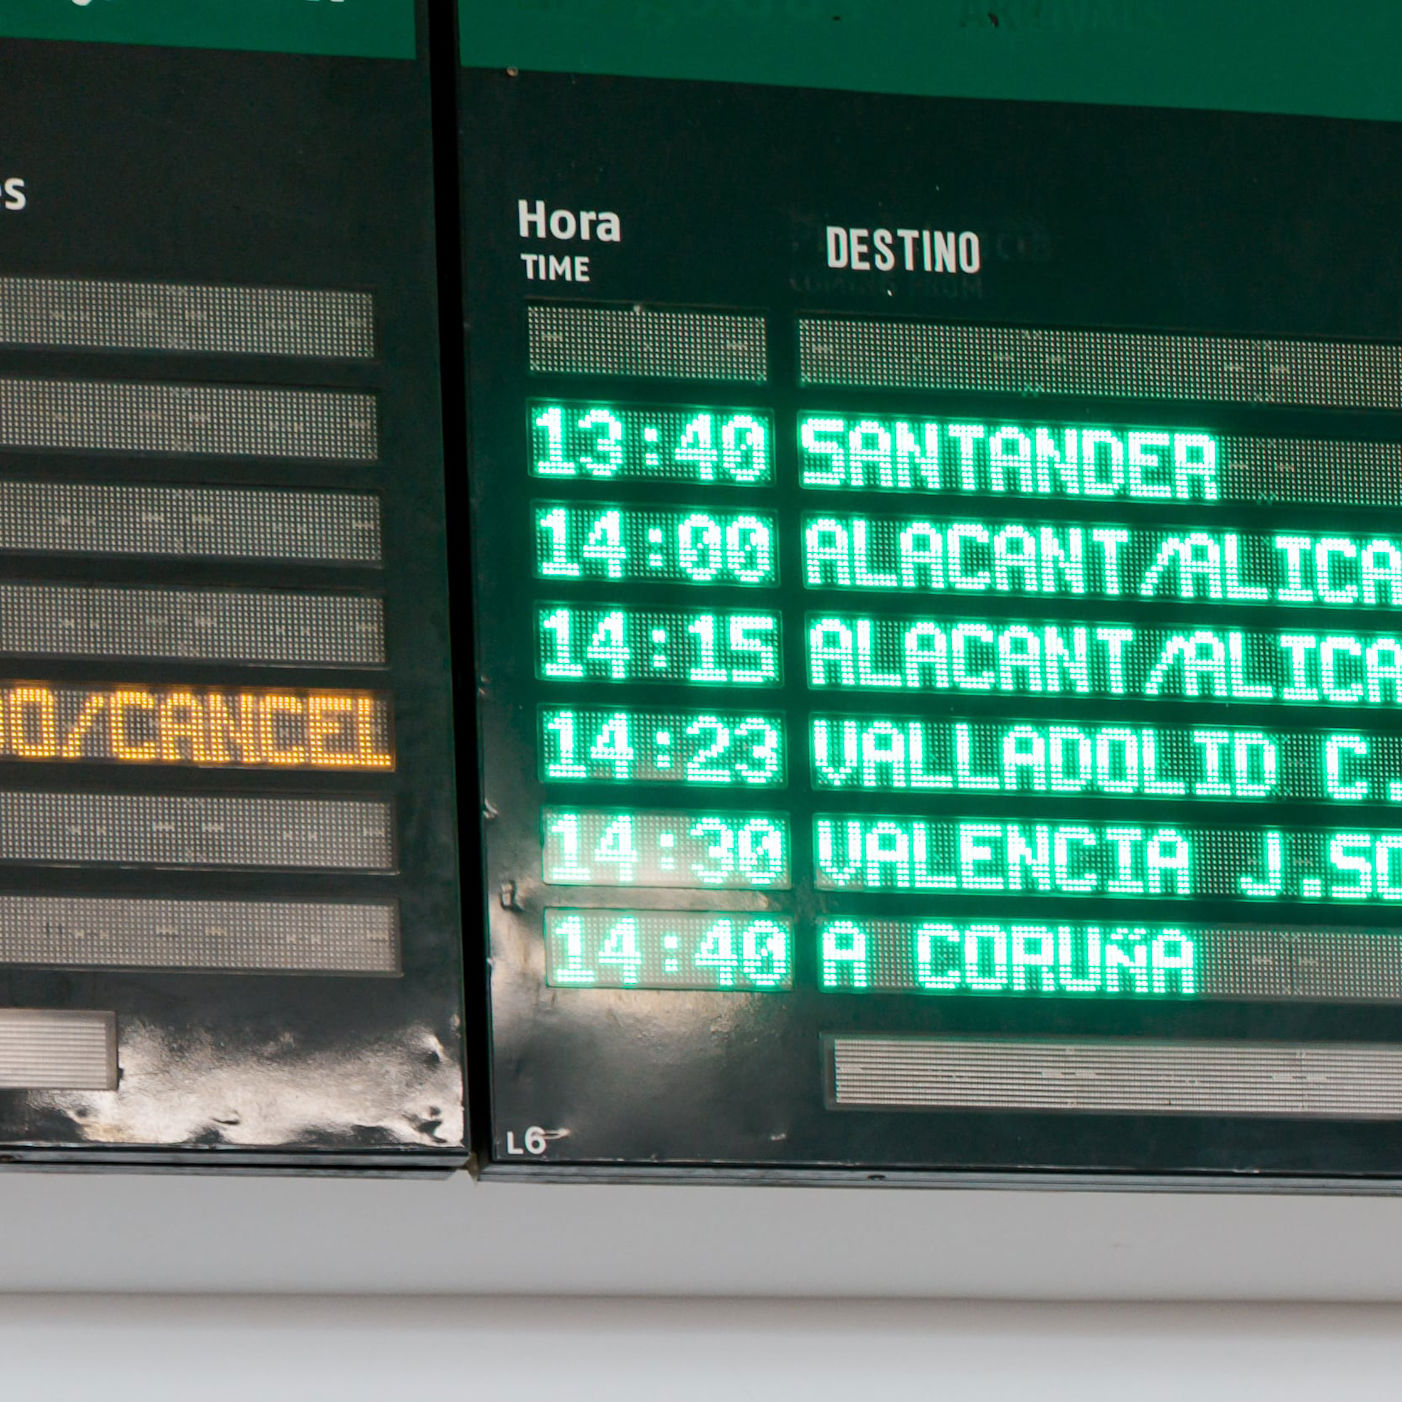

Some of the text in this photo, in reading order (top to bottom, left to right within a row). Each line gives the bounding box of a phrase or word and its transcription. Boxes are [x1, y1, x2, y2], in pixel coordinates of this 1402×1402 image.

[518, 199, 621, 242] Hora
[827, 226, 980, 274] DESTINO
[520, 253, 590, 282] TIME
[535, 406, 766, 482] 13:40
[801, 418, 1218, 500] SANTANDER
[539, 508, 771, 583] 14:00
[543, 609, 775, 683] 14:15
[0, 687, 392, 767] O/CANCEL
[547, 710, 779, 784] 14:23
[813, 719, 1277, 798] VALLADOLID
[551, 813, 783, 885] 14:30
[817, 820, 1191, 896] VALENCIA
[555, 914, 788, 987] 14:40
[822, 920, 868, 988] A
[917, 922, 1195, 995] CORUÑA
[507, 1126, 547, 1155] L6
